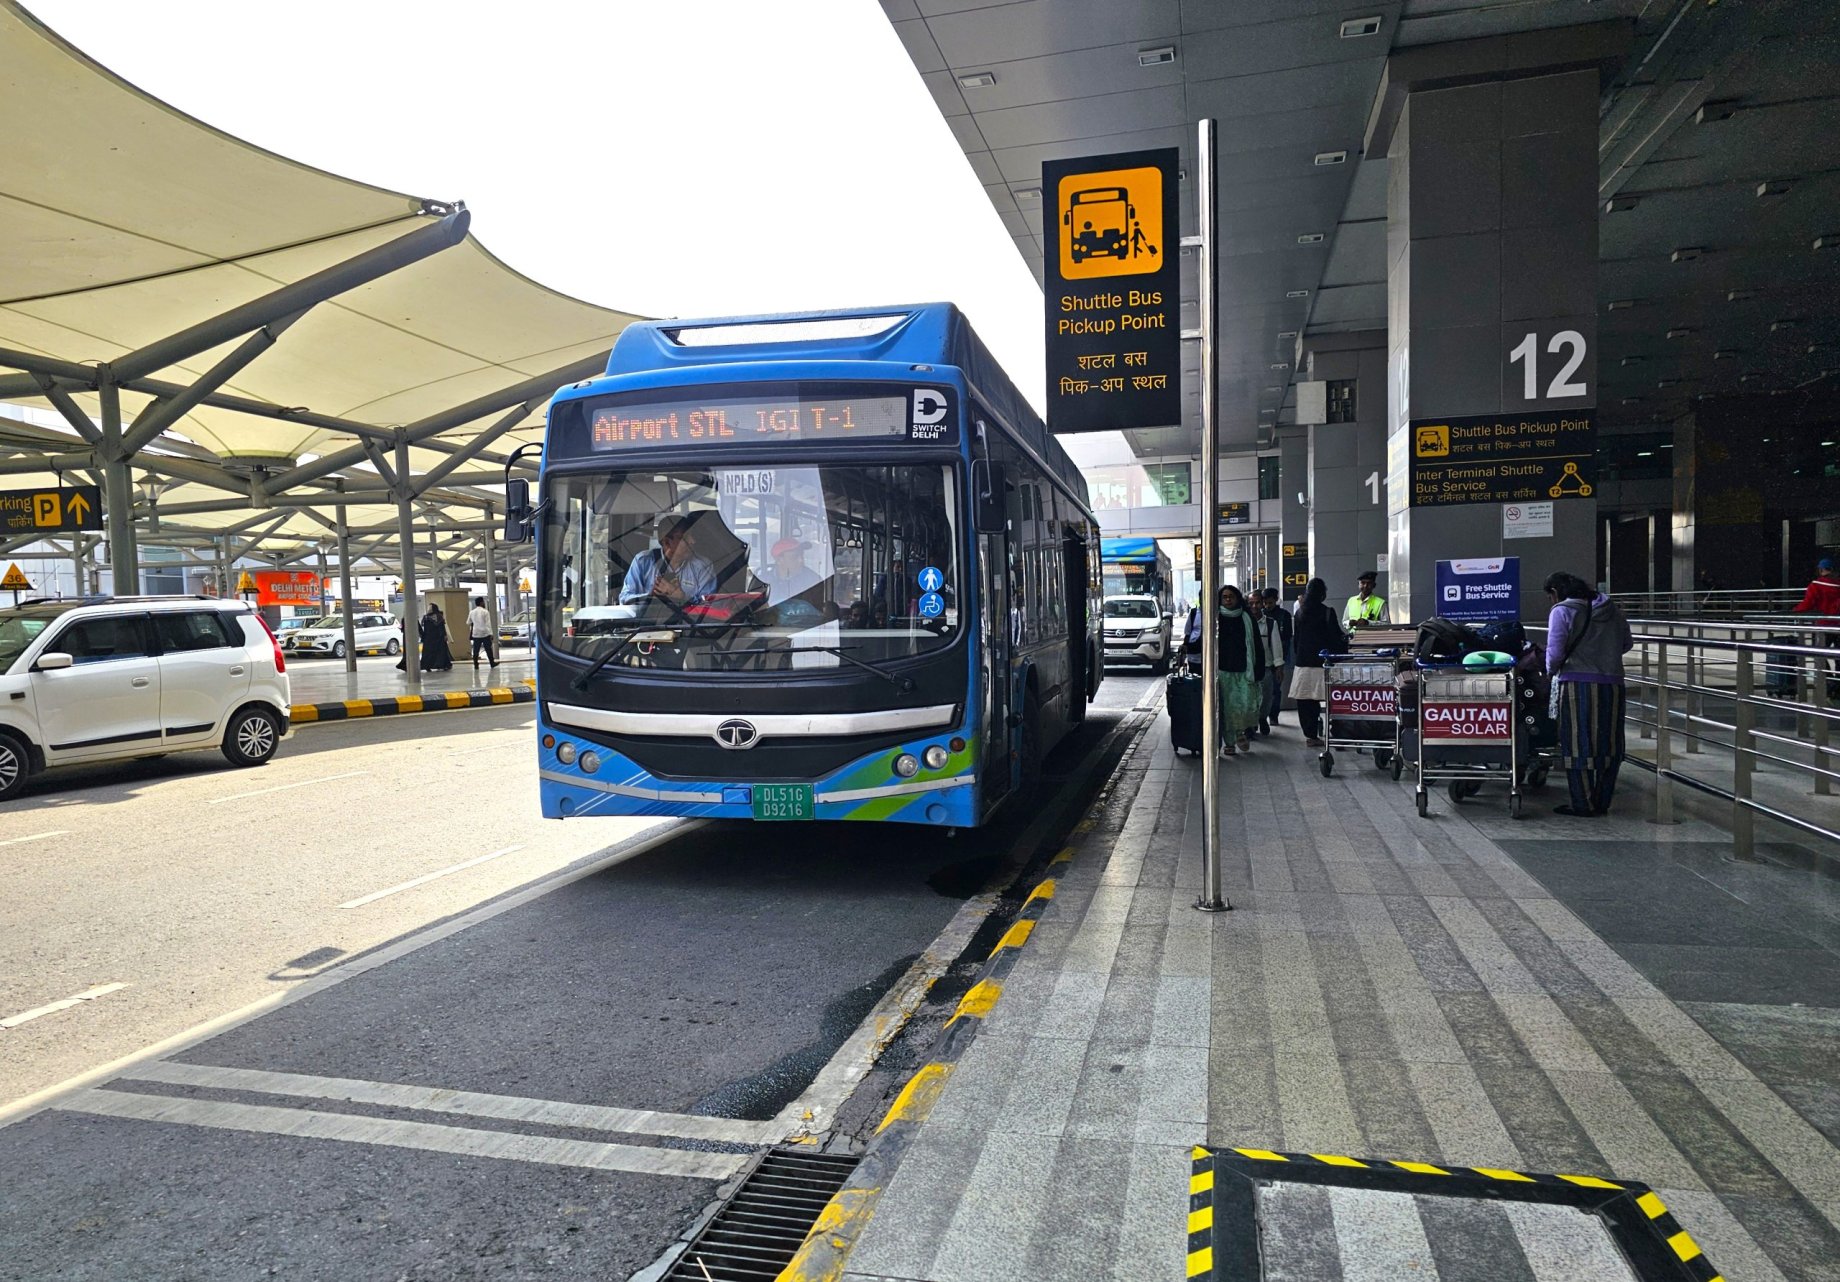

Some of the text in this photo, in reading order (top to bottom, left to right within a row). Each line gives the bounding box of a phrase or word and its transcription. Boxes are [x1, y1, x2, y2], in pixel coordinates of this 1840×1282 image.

[1061, 290, 1162, 311] Shuttle Bus
[1059, 313, 1165, 335] Pickup Point
[1077, 352, 1148, 370] शटल बस
[1510, 330, 1587, 400] 12
[1131, 375, 1167, 390] स्थल
[594, 406, 855, 442] Airport STL IGI T-1
[912, 424, 947, 432] SWITCH
[1452, 419, 1590, 438] Shuttle Bus Pickup Point
[912, 431, 939, 439] DELHI
[1452, 444, 1473, 453] शटल
[1478, 442, 1491, 451] बस
[1536, 439, 1555, 448] स्थल
[1416, 464, 1544, 480] Inter Terminal Shuttle
[726, 471, 773, 493] NPLD (S)
[1365, 471, 1388, 505] 1
[1416, 481, 1486, 493] Bus Service
[7, 574, 22, 583] 36
[1483, 583, 1512, 592] Shuttle
[1465, 591, 1510, 600] Bus Service
[1331, 690, 1394, 701] GAUTAM
[1351, 702, 1394, 712] SOLAR
[1425, 708, 1508, 722] GAUTAM
[1451, 723, 1508, 735] SOLAR
[763, 788, 803, 801] DL51G
[763, 803, 803, 816] D9216
